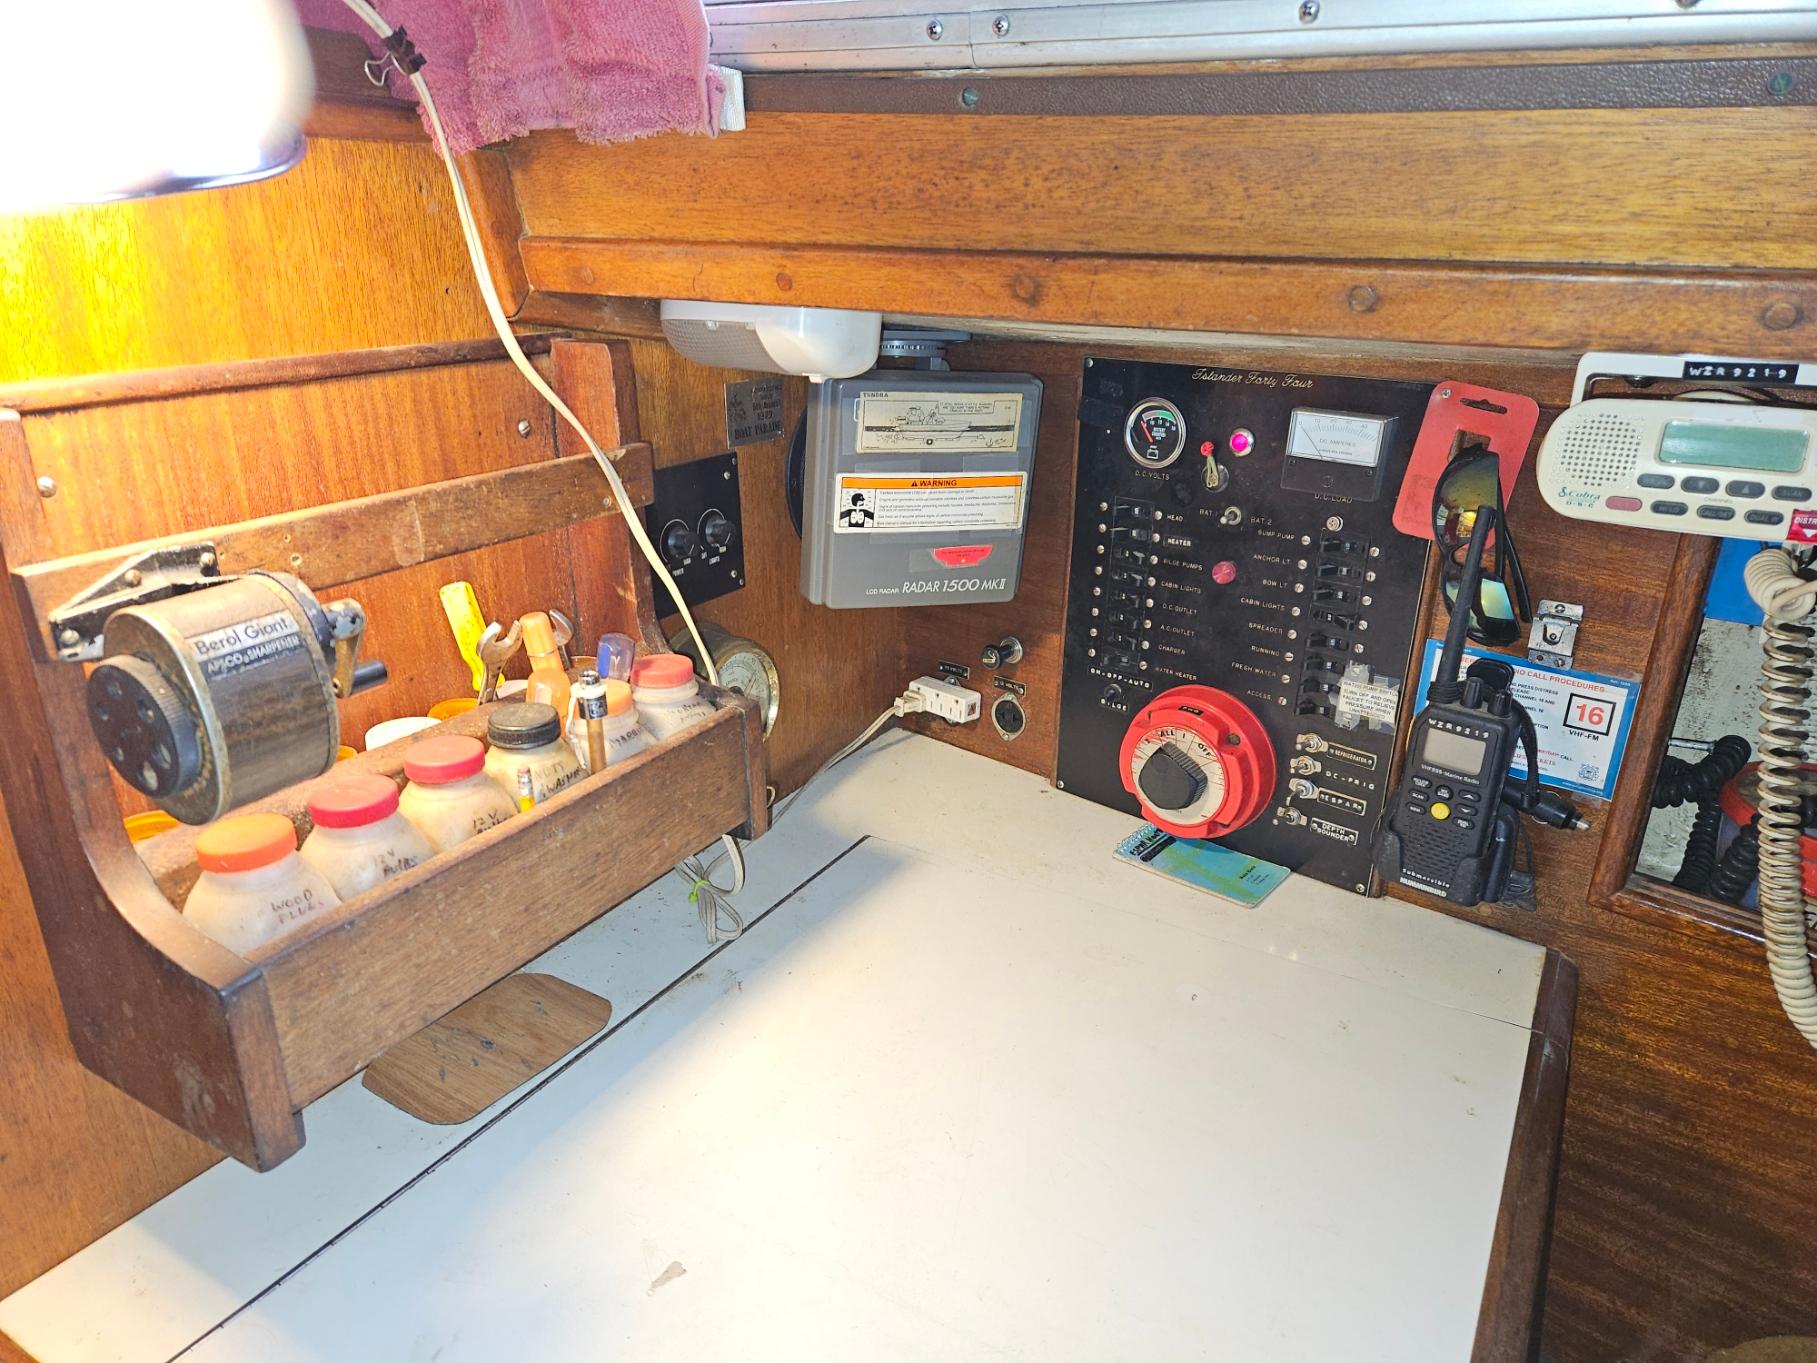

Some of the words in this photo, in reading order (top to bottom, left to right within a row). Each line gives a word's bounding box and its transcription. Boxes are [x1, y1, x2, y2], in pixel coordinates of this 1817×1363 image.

[1192, 368, 1242, 384] Islander
[1246, 372, 1278, 388] Forty
[1281, 374, 1314, 389] Four
[919, 479, 958, 487] WARNING
[1166, 514, 1184, 522] HEAD
[1267, 518, 1273, 526] 2
[1167, 537, 1192, 547] HEATER
[1252, 554, 1280, 563] ANCHOR
[1182, 561, 1203, 571] PUMPS
[866, 588, 878, 596] LCD
[879, 587, 900, 595] RADAR
[902, 580, 941, 594] RADAR
[942, 578, 980, 593] 1500
[1160, 581, 1179, 589] CABIN
[1262, 579, 1277, 587] BOW
[1240, 597, 1260, 606] CABIN
[1262, 601, 1286, 611] LIGHTS
[1248, 622, 1284, 635] SPREADER
[194, 628, 243, 655] Berol
[243, 617, 289, 640] Giant
[1251, 645, 1280, 657] RUNNING
[1231, 661, 1253, 673] FRESH
[1527, 670, 1548, 681] CALL
[1549, 675, 1606, 694] PROCEDURES
[1576, 703, 1606, 726] 16
[1160, 729, 1175, 738] ALL
[1569, 729, 1600, 741] VHF-FM
[1197, 742, 1212, 756] OFF
[1463, 776, 1480, 786] Radio
[488, 808, 498, 820] V
[1321, 823, 1345, 835] DEPTH
[270, 888, 313, 913] WOOD
